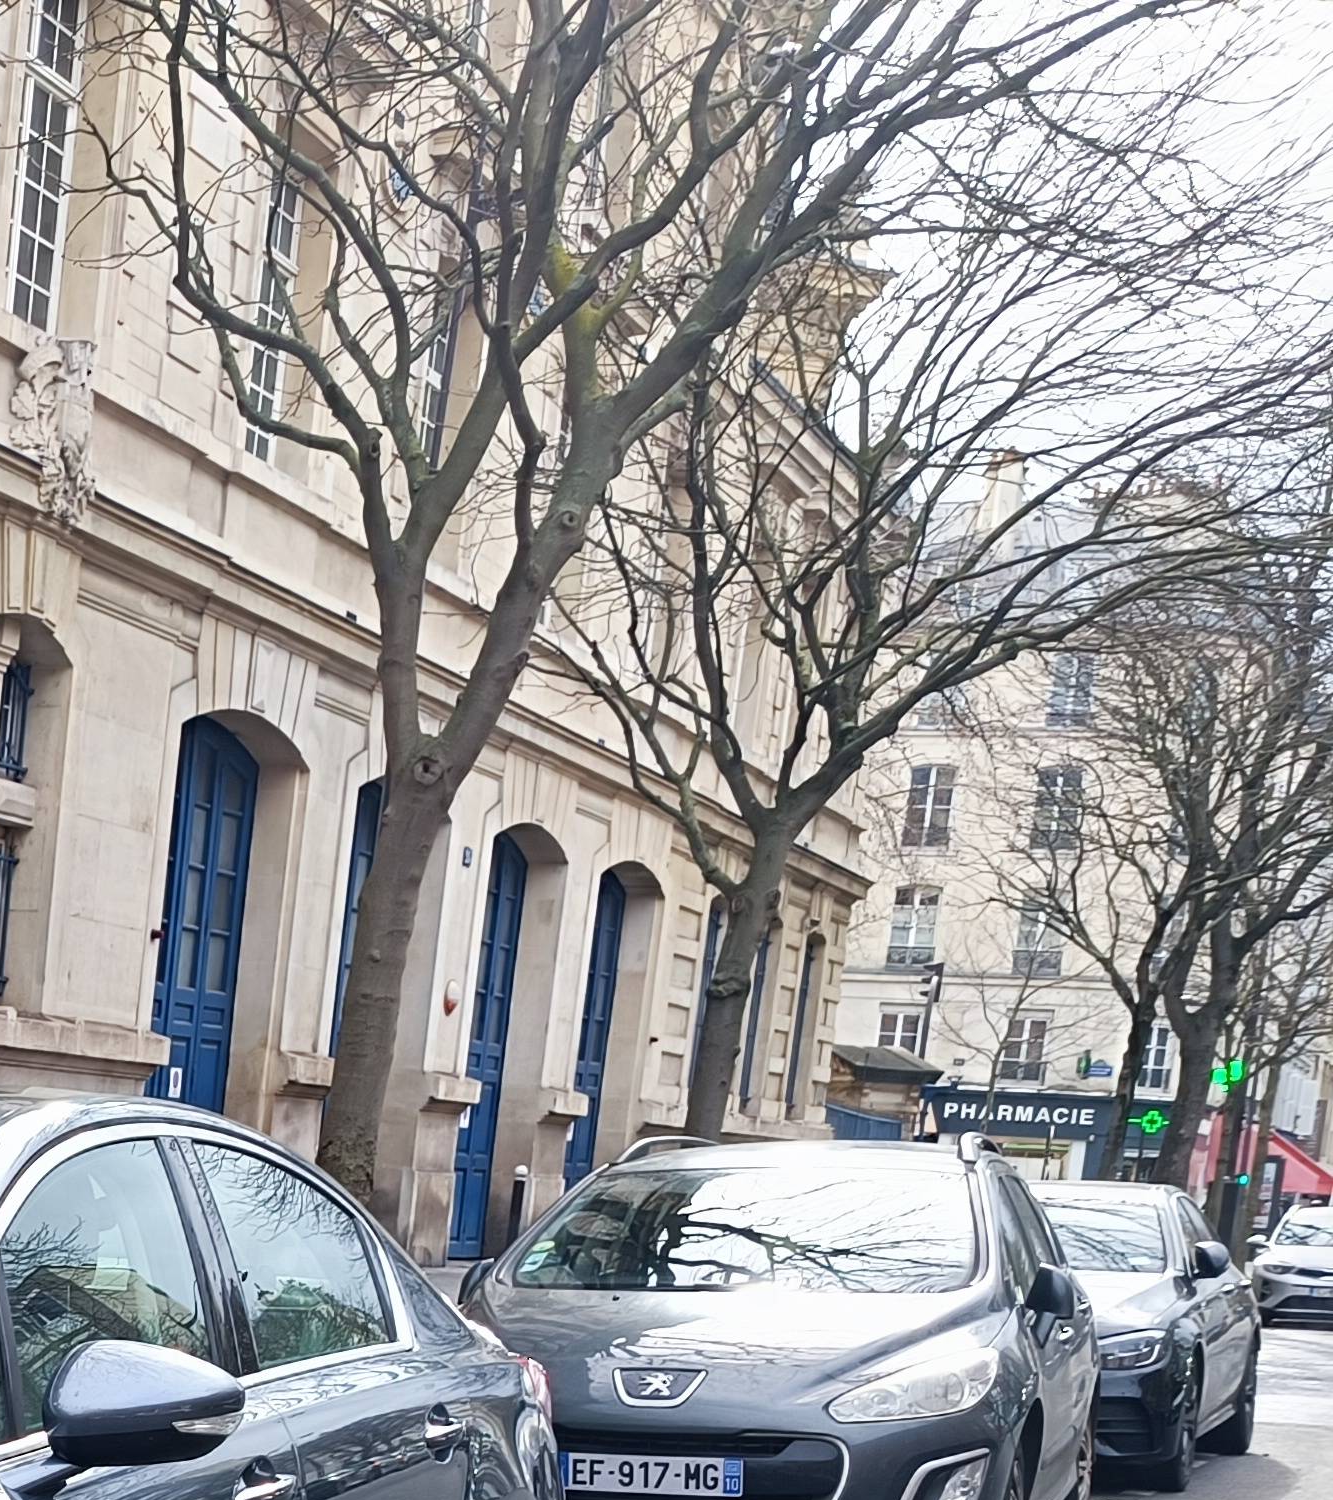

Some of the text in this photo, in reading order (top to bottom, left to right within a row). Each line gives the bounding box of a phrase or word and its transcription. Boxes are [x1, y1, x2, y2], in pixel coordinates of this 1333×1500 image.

[943, 1102, 1096, 1125] PHARMACIE
[571, 1458, 720, 1491] EF-917-MG
[725, 1477, 739, 1491] 10
